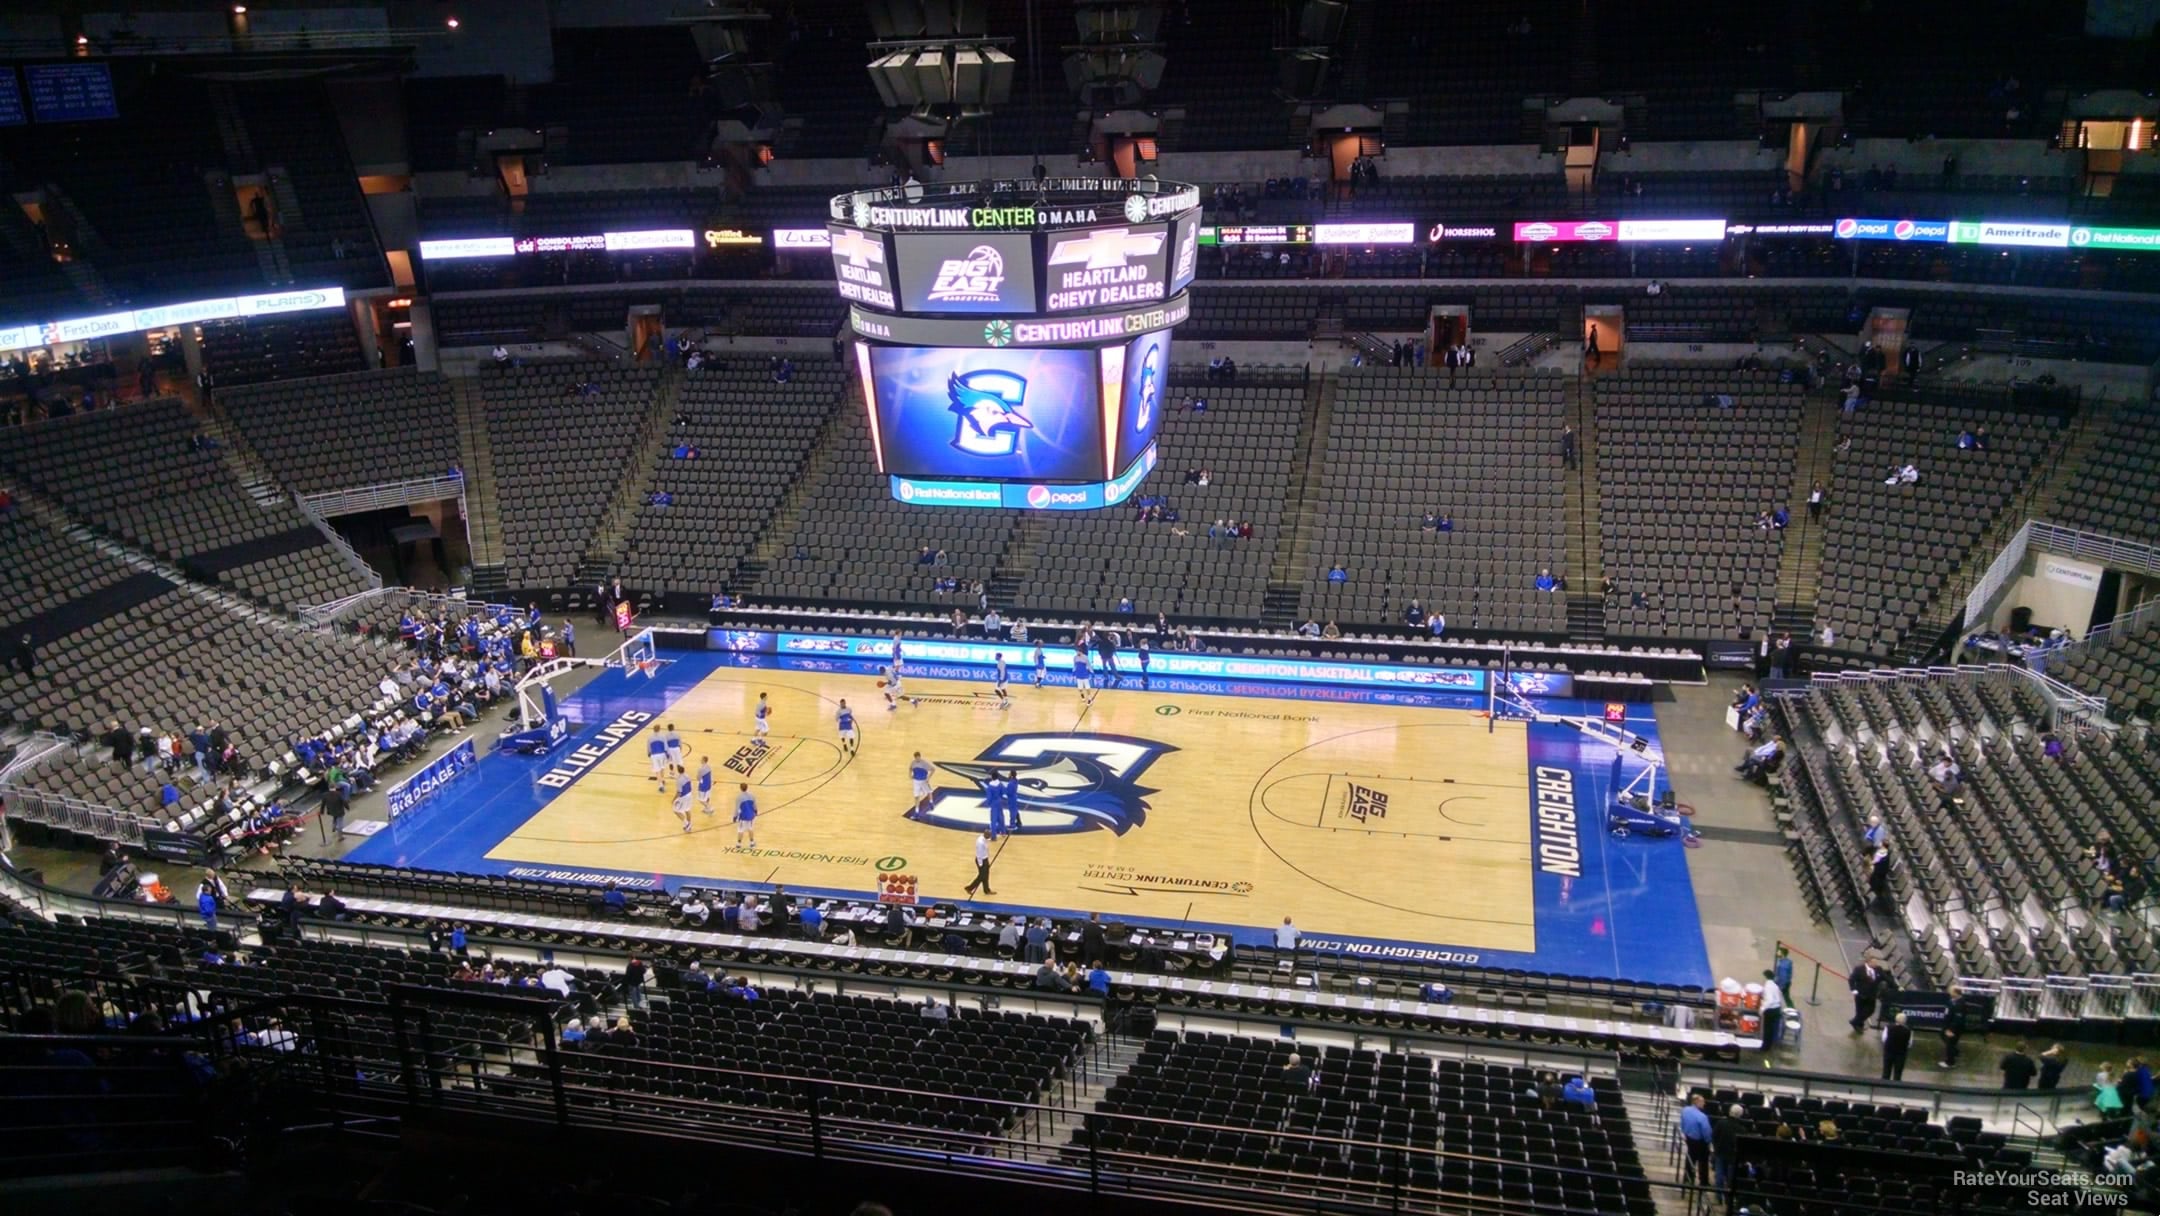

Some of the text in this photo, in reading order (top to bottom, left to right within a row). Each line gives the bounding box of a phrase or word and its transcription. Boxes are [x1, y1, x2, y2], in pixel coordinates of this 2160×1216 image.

[871, 206, 1097, 227] CENTURYLINK CENTER OMAHA
[801, 233, 830, 243] LEX
[1857, 224, 1888, 234] pepsi
[1915, 226, 1945, 237] pepsi
[1985, 227, 2062, 239] Ameritrade
[537, 236, 605, 246] CONSOLIDATED
[840, 264, 882, 287] HEARTLAND
[939, 260, 991, 277] BIG
[1063, 265, 1147, 288] HEARTLAND
[932, 276, 1004, 292] EAST
[839, 281, 895, 310] CHEVY DEALERS
[1049, 281, 1165, 309] CHEVY DEALERS
[63, 324, 89, 337] First
[90, 321, 119, 333] Data
[1014, 318, 1123, 342] CENTURYLINK
[1125, 310, 1164, 332] CENTER
[1051, 491, 1087, 504] pepsi
[872, 641, 927, 658] CAPING
[926, 644, 970, 660] WORLD
[1169, 657, 1224, 674] SUPPORT
[1225, 661, 1298, 678] CREIGHTON
[1299, 664, 1374, 681] BASKETBALL
[1188, 708, 1215, 716] First
[1217, 710, 1281, 721] National
[1282, 714, 1321, 723] Bank
[537, 710, 652, 788] BLUEJAYS
[723, 745, 752, 770] BIG
[734, 743, 771, 775] EAST
[391, 764, 456, 817] BIRDCAGE
[1351, 785, 1371, 824] EAST
[1369, 790, 1389, 819] BIG
[1536, 766, 1581, 877] CREIGHTON
[723, 845, 763, 857] Bank
[764, 850, 835, 863] National
[837, 855, 869, 866] First
[1088, 863, 1135, 872] OMAHA
[1083, 869, 1229, 890] CENTURYLINK CENTER
[1299, 938, 1480, 964] GOCREIGHTON.COM
